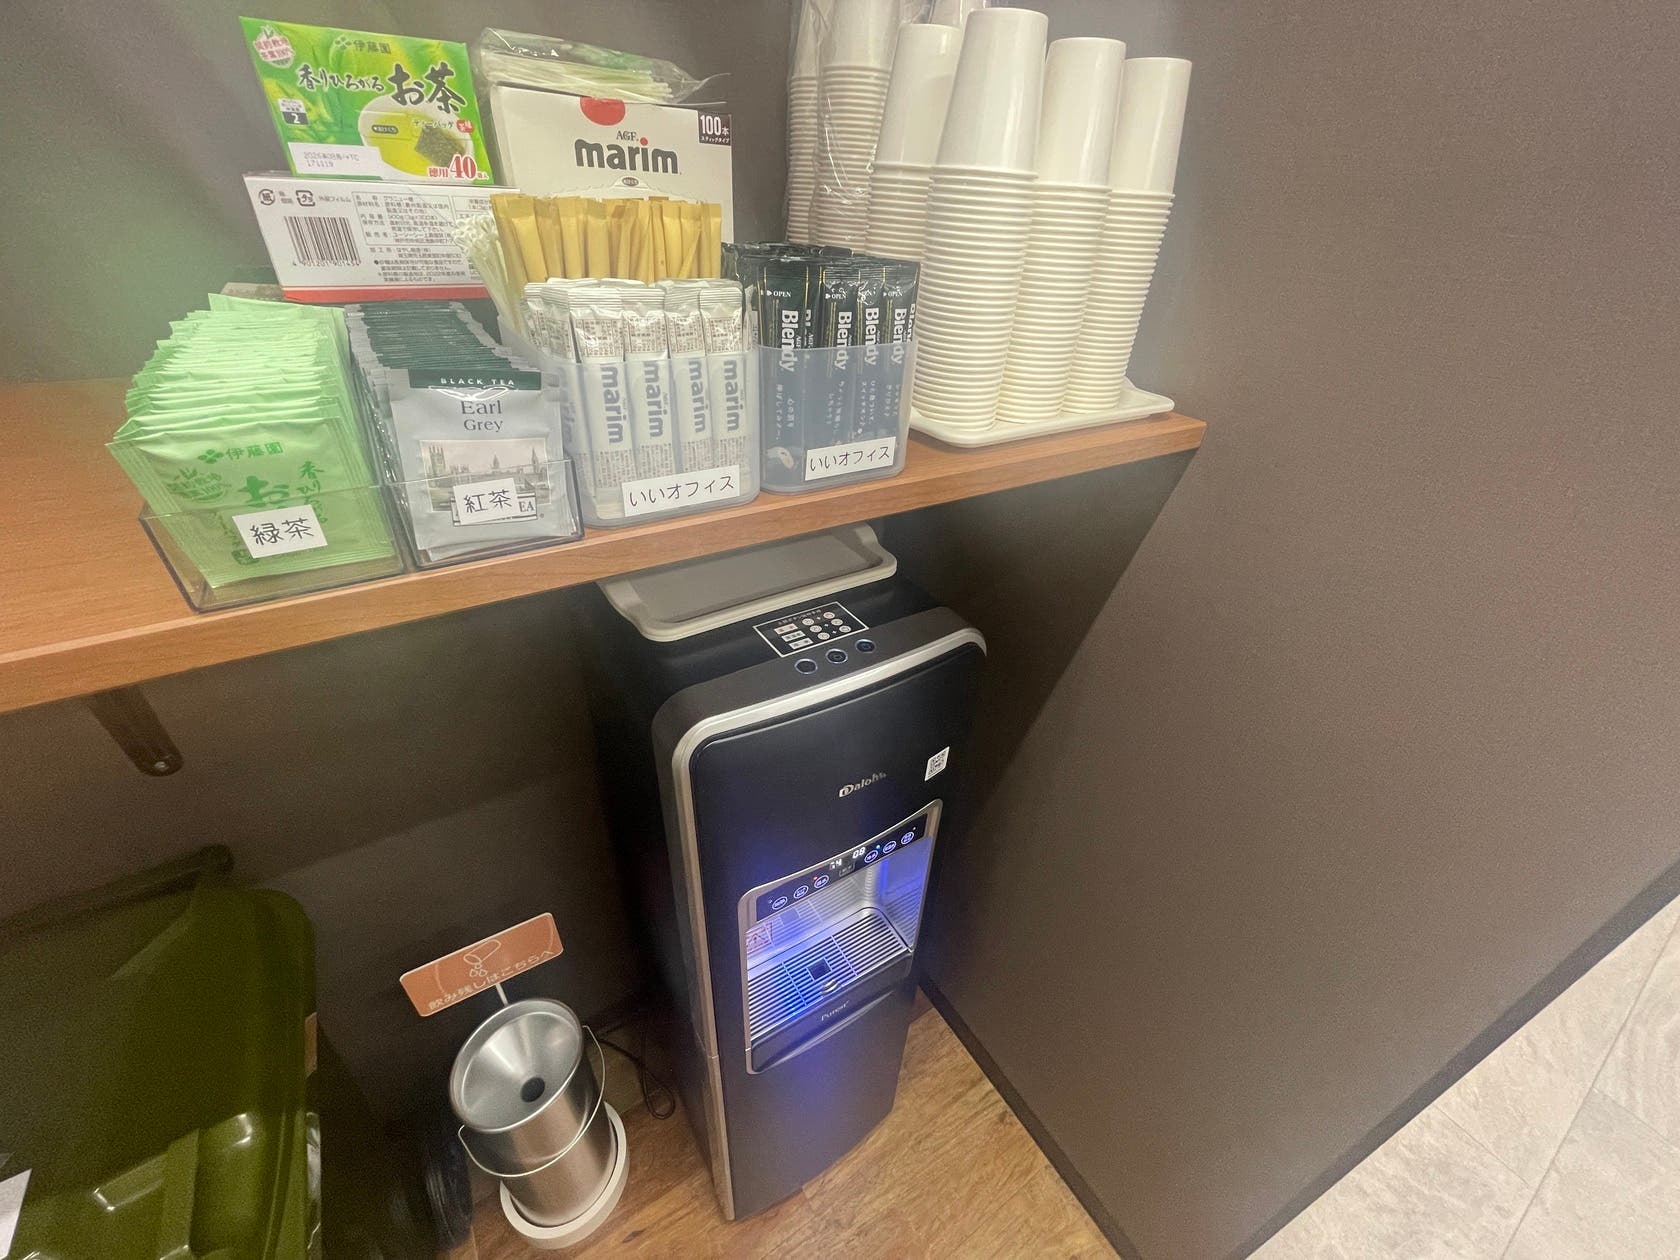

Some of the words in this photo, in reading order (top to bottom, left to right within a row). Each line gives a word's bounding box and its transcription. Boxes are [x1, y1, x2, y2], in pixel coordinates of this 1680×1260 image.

[353, 39, 391, 54] 伊藤園
[291, 113, 301, 124] 2
[700, 114, 730, 137] 100本
[574, 136, 679, 175] marim
[773, 290, 792, 298] OPEN
[779, 309, 799, 372] Blendy
[834, 311, 853, 370] Blendy
[864, 307, 880, 366] Blendy
[891, 308, 908, 365] Blendy
[440, 377, 484, 386] BLACK
[491, 378, 515, 387] TEA
[688, 360, 709, 434] marim
[723, 359, 744, 433] marim
[461, 400, 503, 416] Earl
[600, 364, 627, 445] marim
[643, 361, 669, 438] marim
[463, 418, 504, 433] Grey
[809, 445, 891, 472] いいオフィス
[463, 489, 512, 514] 紅茶
[629, 474, 735, 507] いいオフィス
[250, 517, 315, 546] 緑茶
